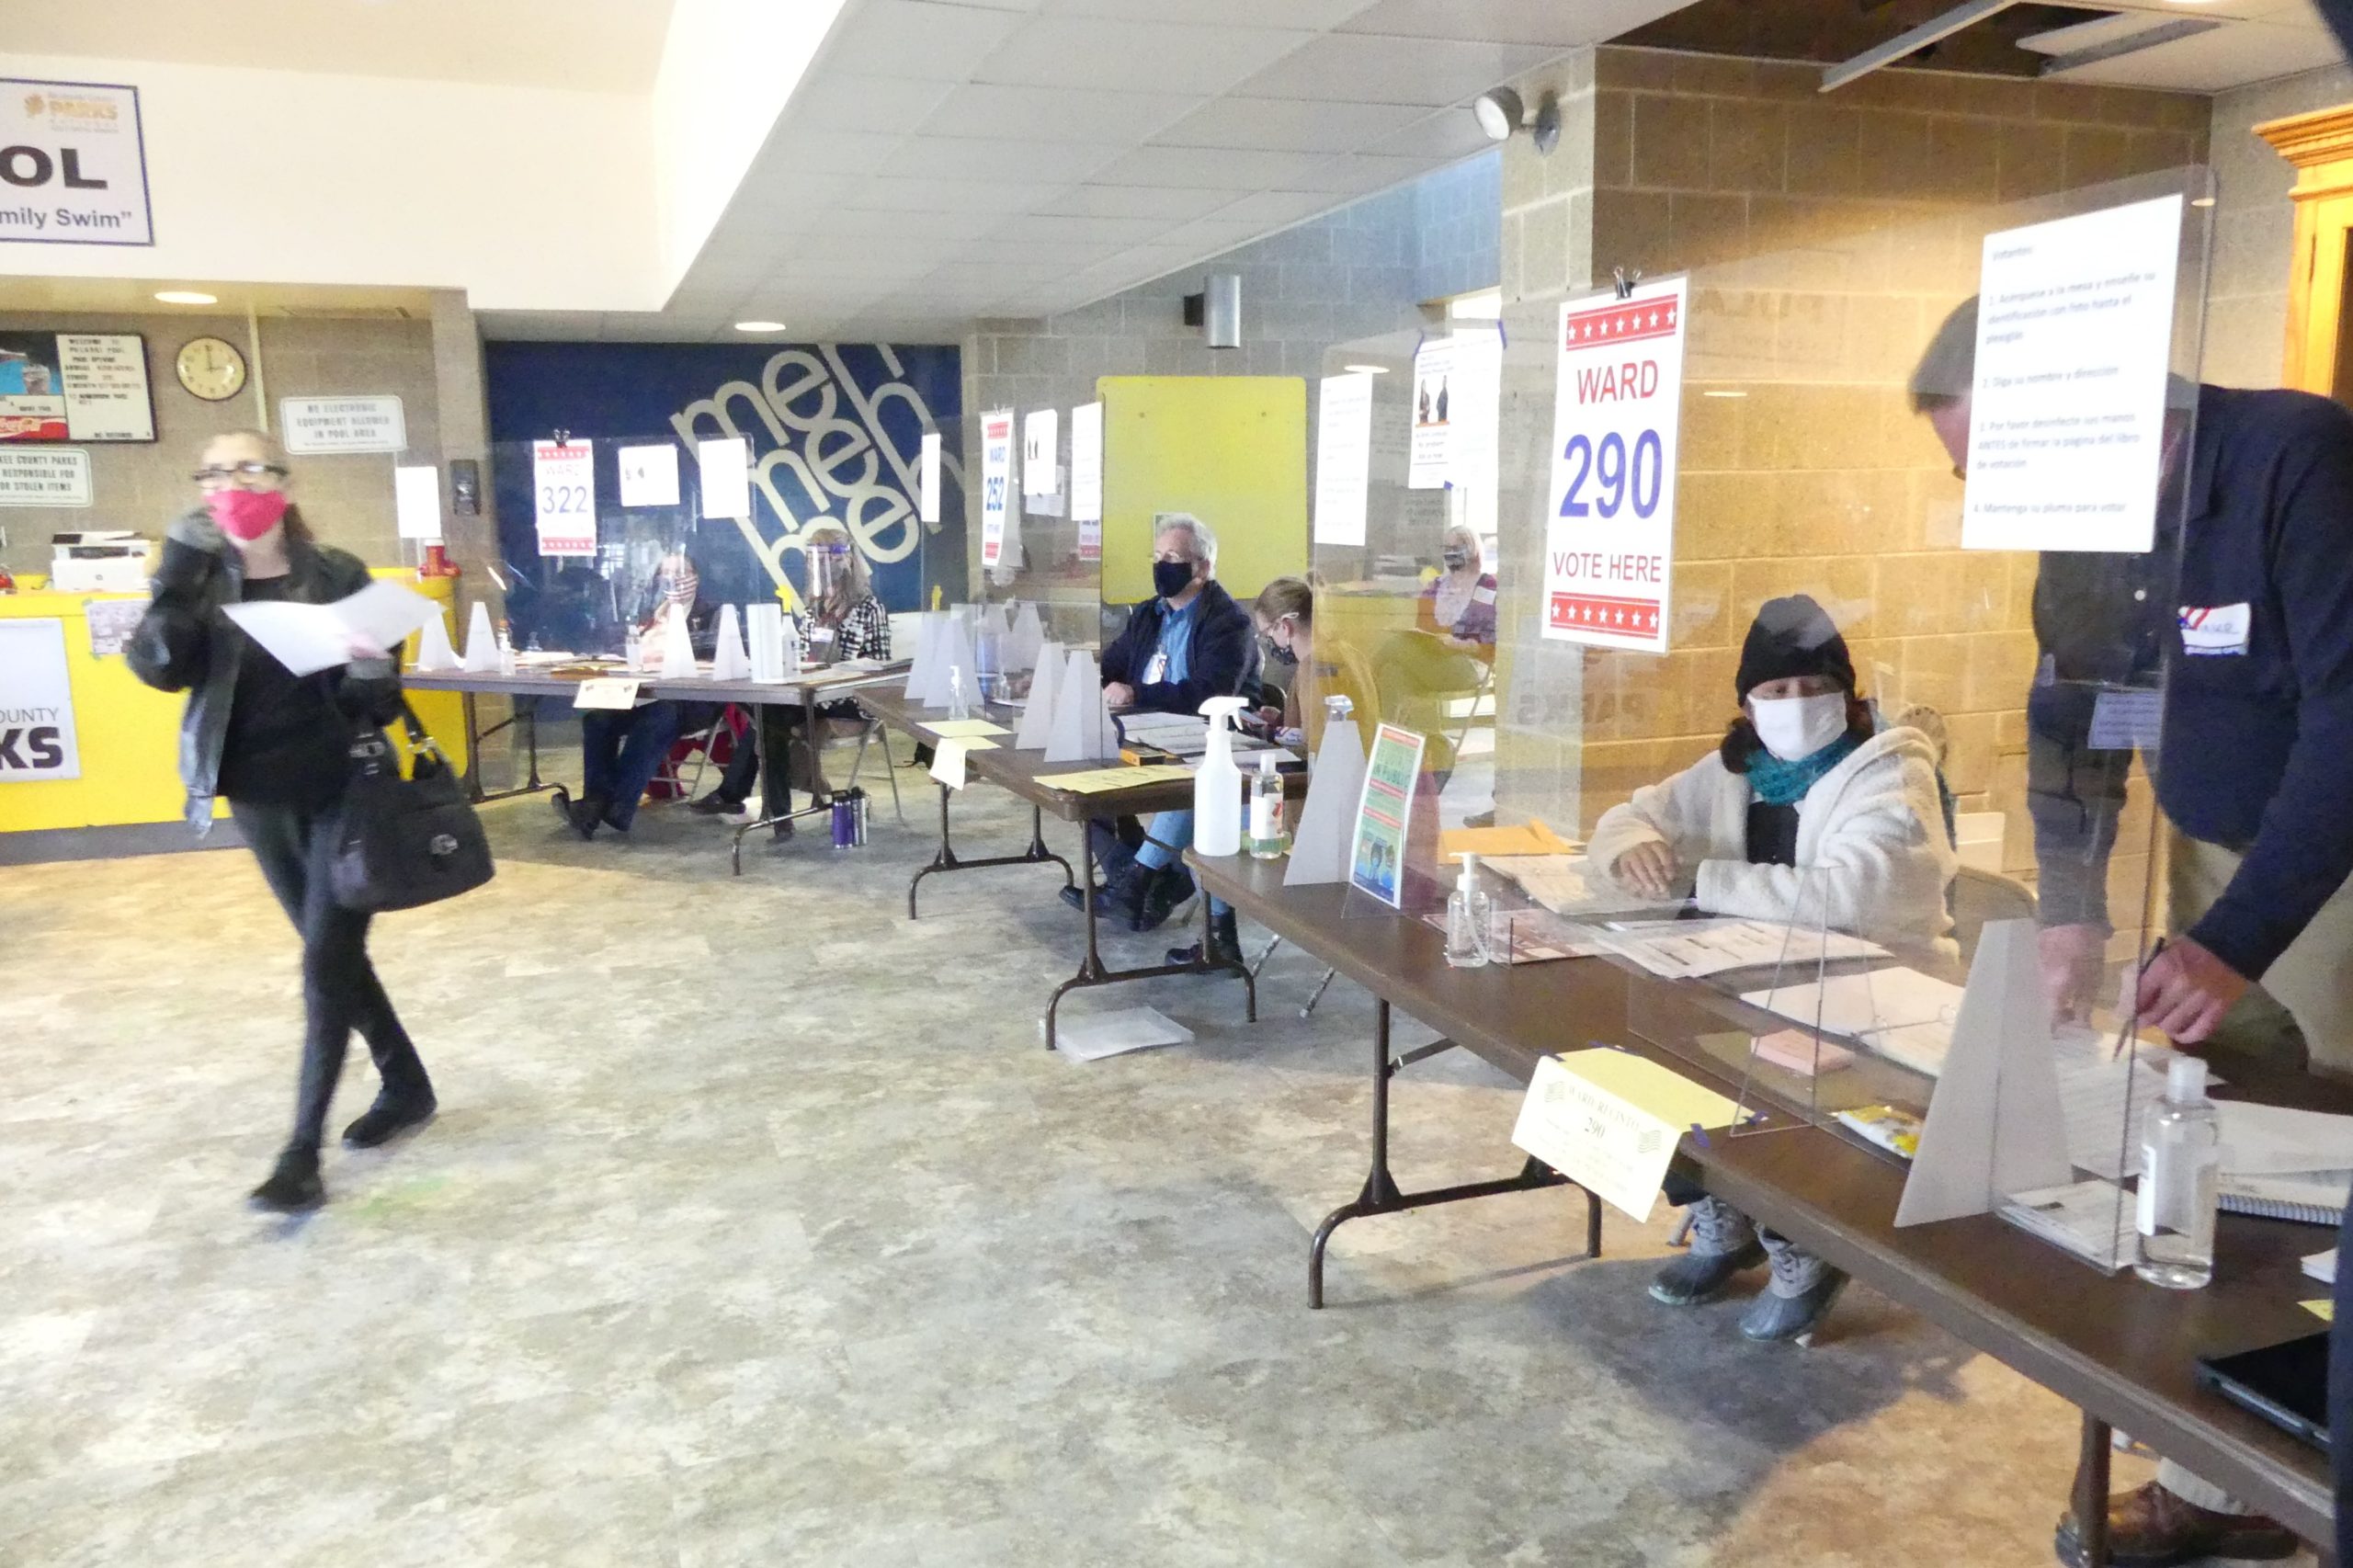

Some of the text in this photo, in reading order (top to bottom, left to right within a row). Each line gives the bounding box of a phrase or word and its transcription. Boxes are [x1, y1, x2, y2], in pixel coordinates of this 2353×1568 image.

[1577, 358, 1658, 404] WARD
[297, 416, 390, 427] EQUIPMENT ALLOWED
[328, 429, 349, 438] POOL
[0, 456, 77, 465] EE COUNTY PARKS
[2, 469, 75, 479] RESPONSIBLE FOR
[1559, 428, 1663, 518] 290
[14, 482, 44, 491] STOLEN
[48, 483, 72, 492] ITEMS
[986, 476, 1005, 511] 252
[542, 485, 587, 514] 322
[1553, 551, 1662, 582] VOTE HERE
[1585, 1116, 1606, 1139] 290
